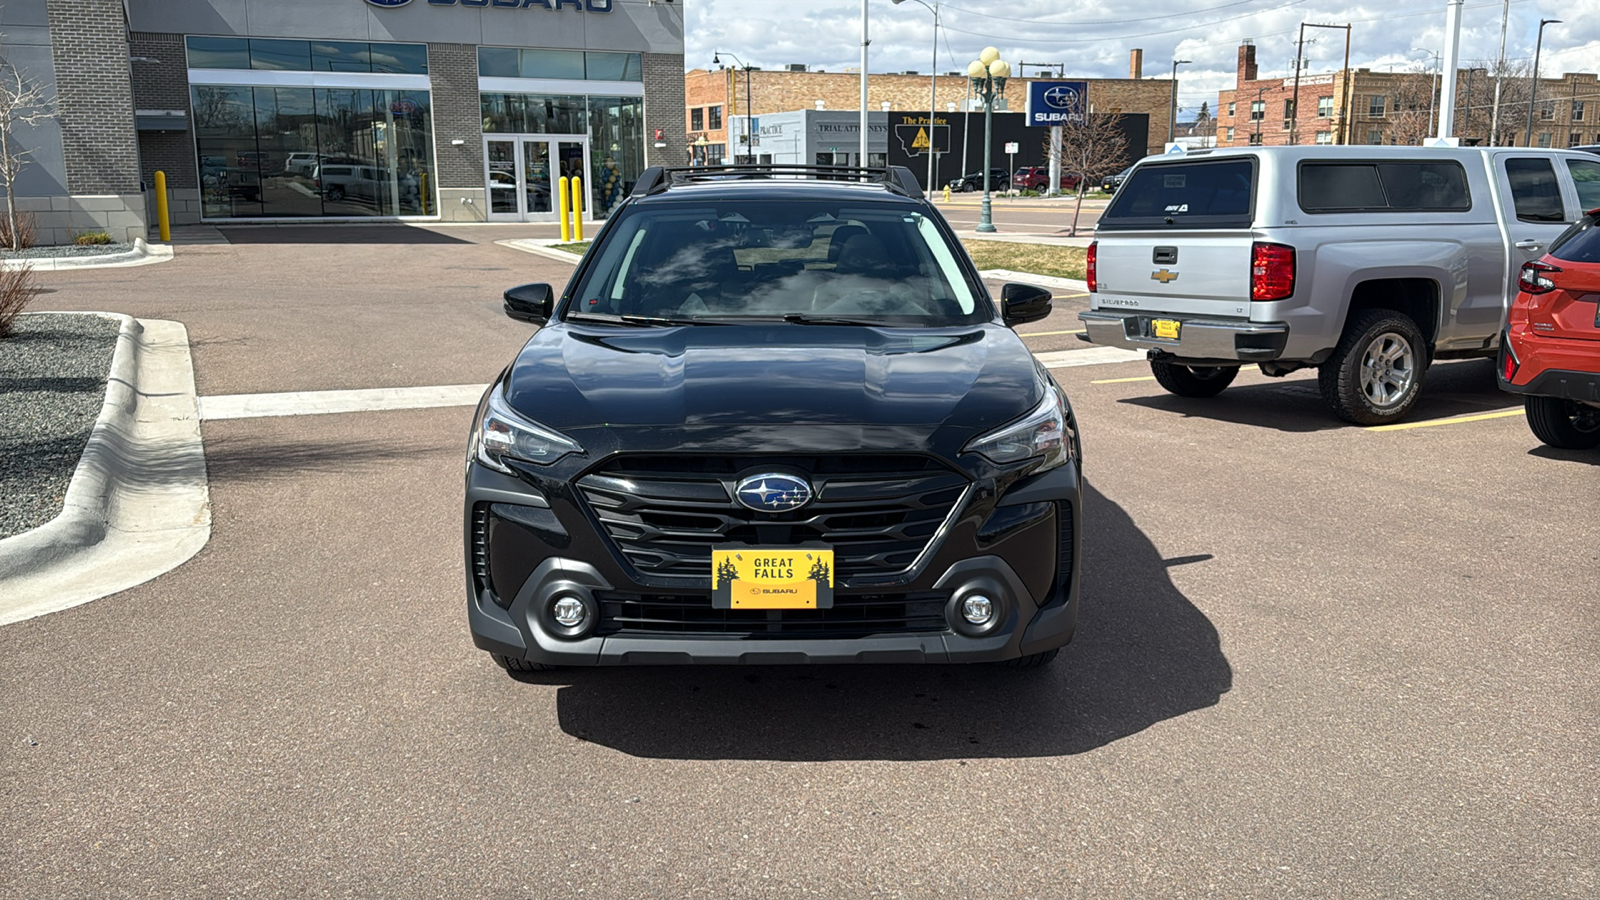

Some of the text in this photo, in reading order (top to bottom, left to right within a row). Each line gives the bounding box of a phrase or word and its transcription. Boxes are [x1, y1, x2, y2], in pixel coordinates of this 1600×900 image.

[902, 116, 947, 125] The Pratice
[1034, 112, 1084, 122] SUBARU
[759, 125, 783, 135] PRACTICE
[818, 124, 842, 132] TRIAL
[754, 558, 794, 568] GREAT
[754, 568, 794, 579] FALLS
